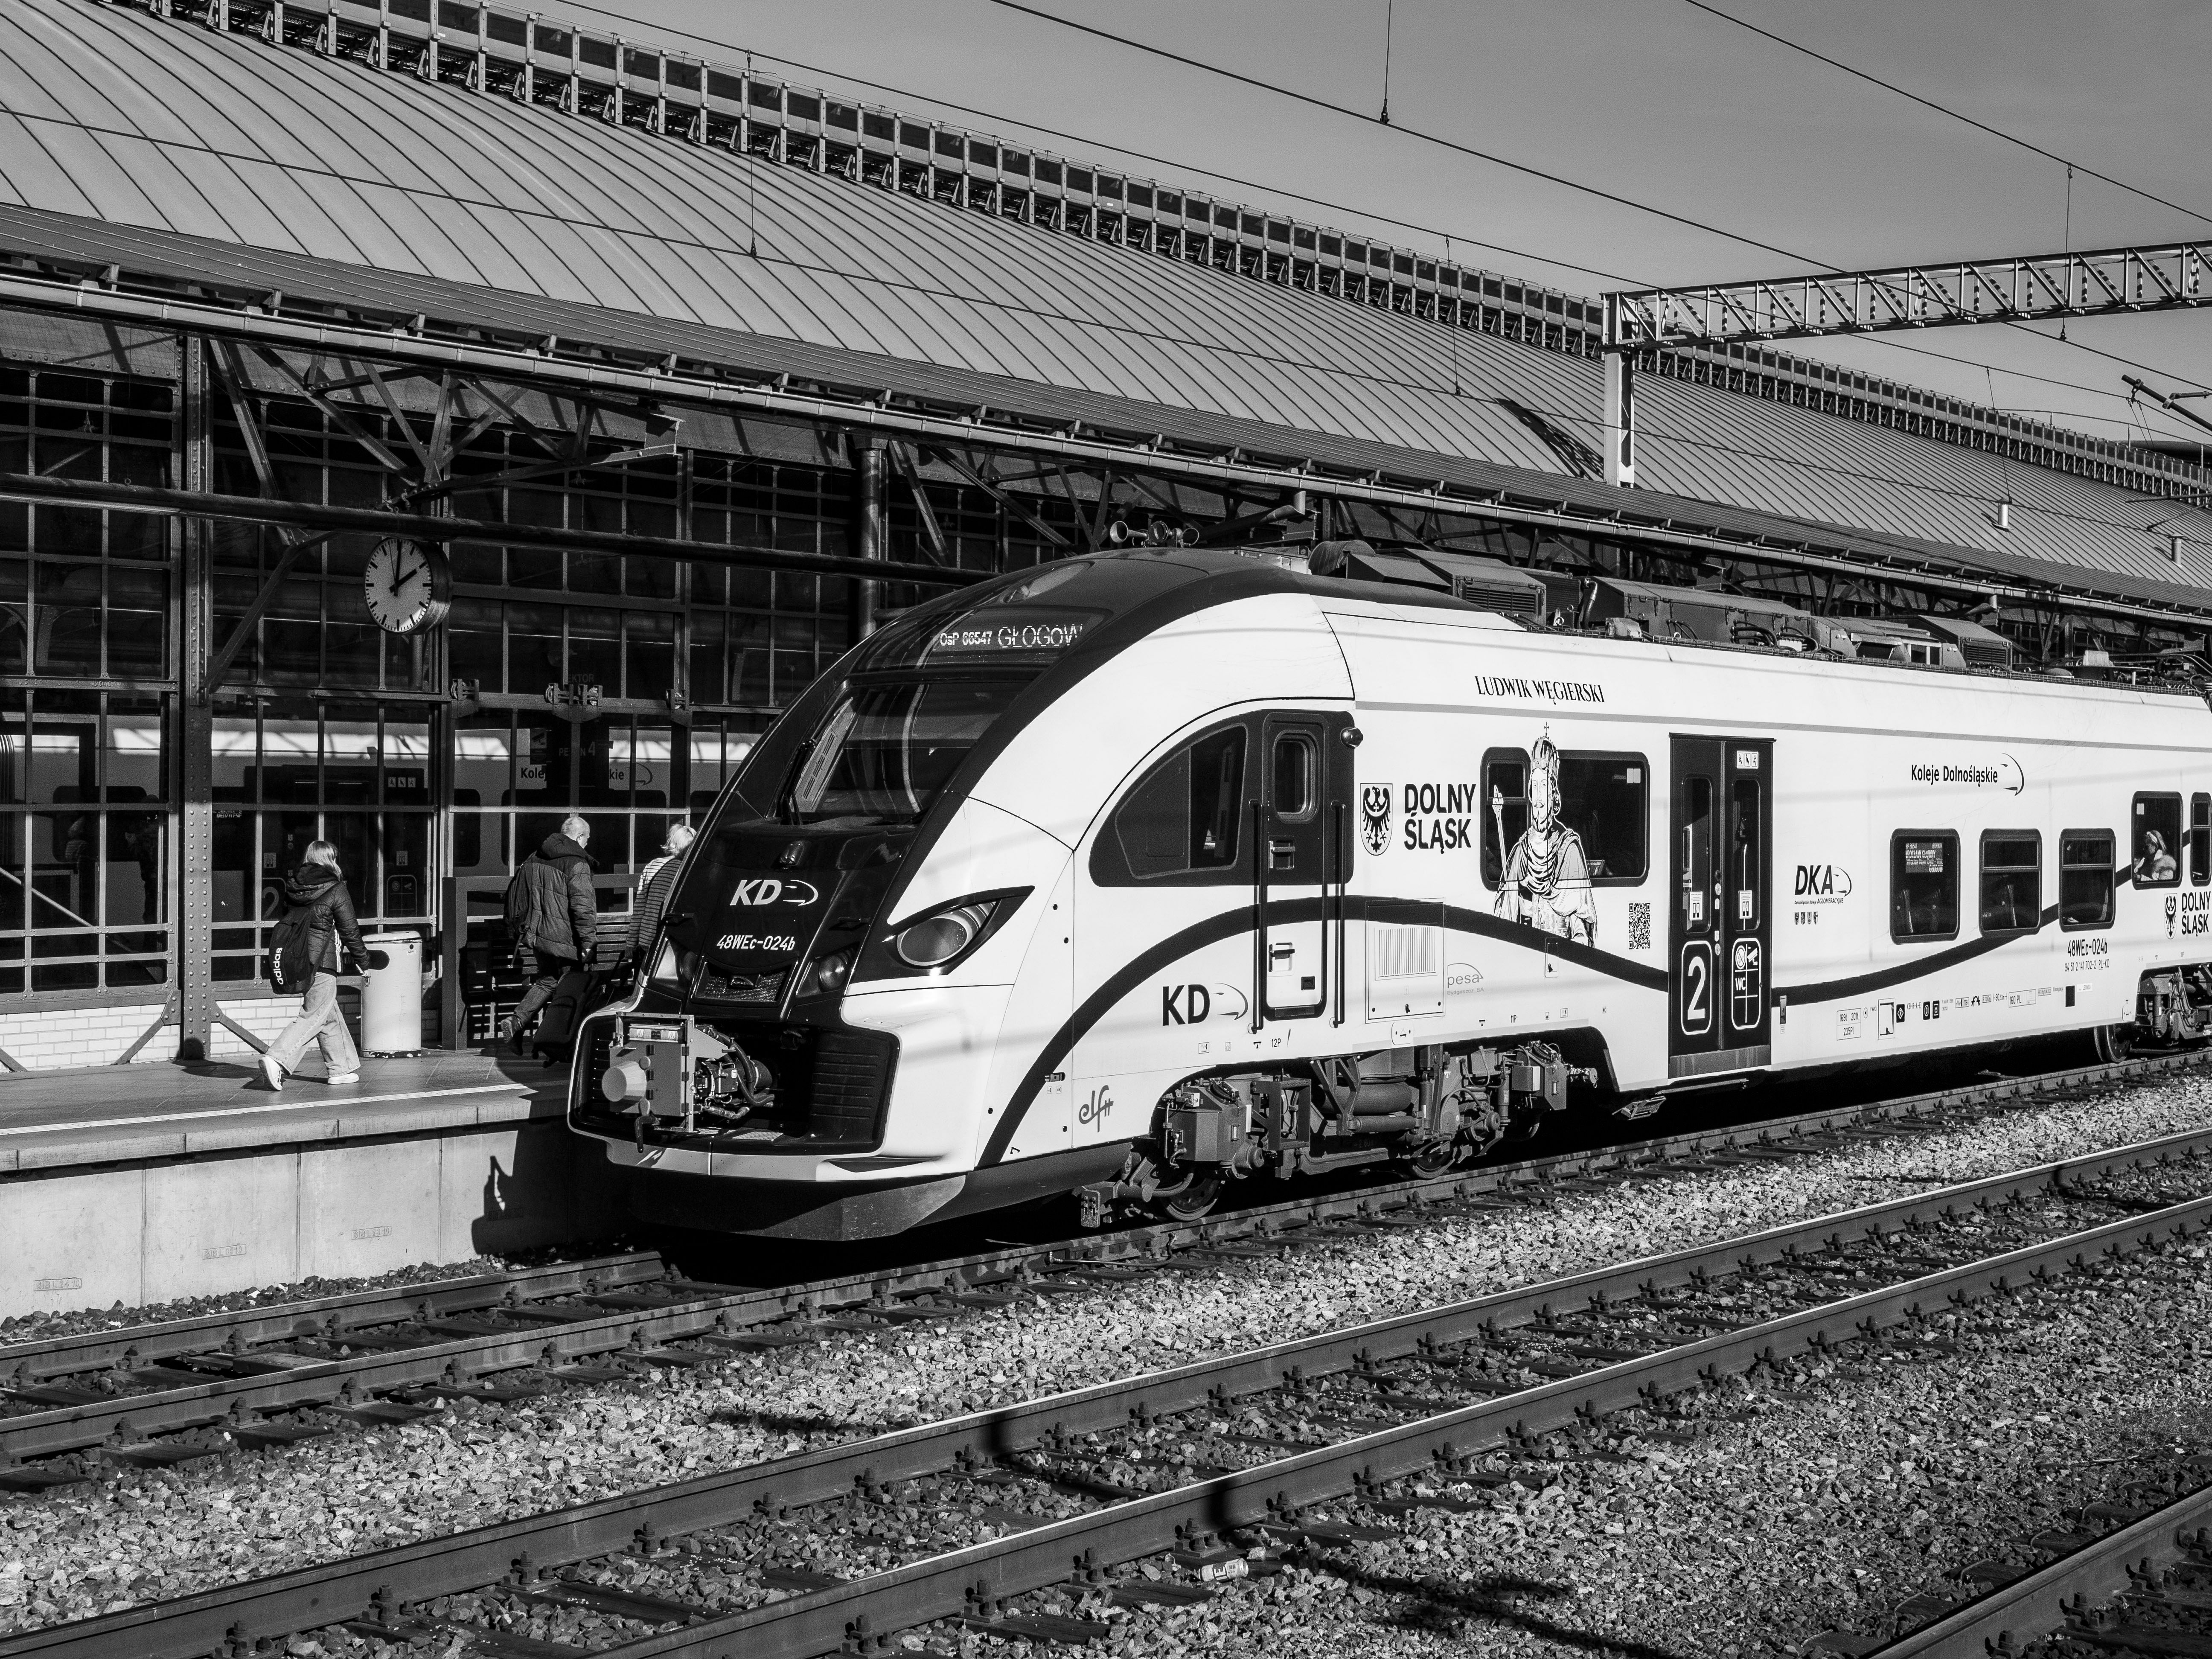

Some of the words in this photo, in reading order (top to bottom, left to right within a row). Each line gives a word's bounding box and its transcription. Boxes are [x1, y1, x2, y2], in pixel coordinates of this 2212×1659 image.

[962, 631, 992, 645] 66547
[1474, 676, 1531, 699] LUDWIK
[1532, 680, 1605, 705] WĘGIERSKI
[559, 748, 586, 757] PEN
[588, 741, 596, 757] 4
[1911, 764, 1939, 786] Koleje
[1943, 765, 1998, 787] Dolnośląskie
[1405, 783, 1476, 814] DOLNY
[1403, 812, 1472, 854] ŚLĄSK
[1795, 865, 1834, 895] DKA
[730, 879, 782, 905] KD
[2182, 891, 2211, 911] DOLNY
[2181, 911, 2209, 937] ŚLĄSK
[716, 934, 796, 951] 48WEc-024b
[2067, 937, 2107, 957] 48WEc-024b
[273, 947, 284, 985] adidas
[2076, 962, 2078, 971] 2
[1447, 974, 1479, 989] pesa
[1688, 956, 1705, 1020] 2
[1735, 978, 1746, 990] WC
[1162, 984, 1210, 1026] KD
[1272, 1038, 1281, 1048] 12P
